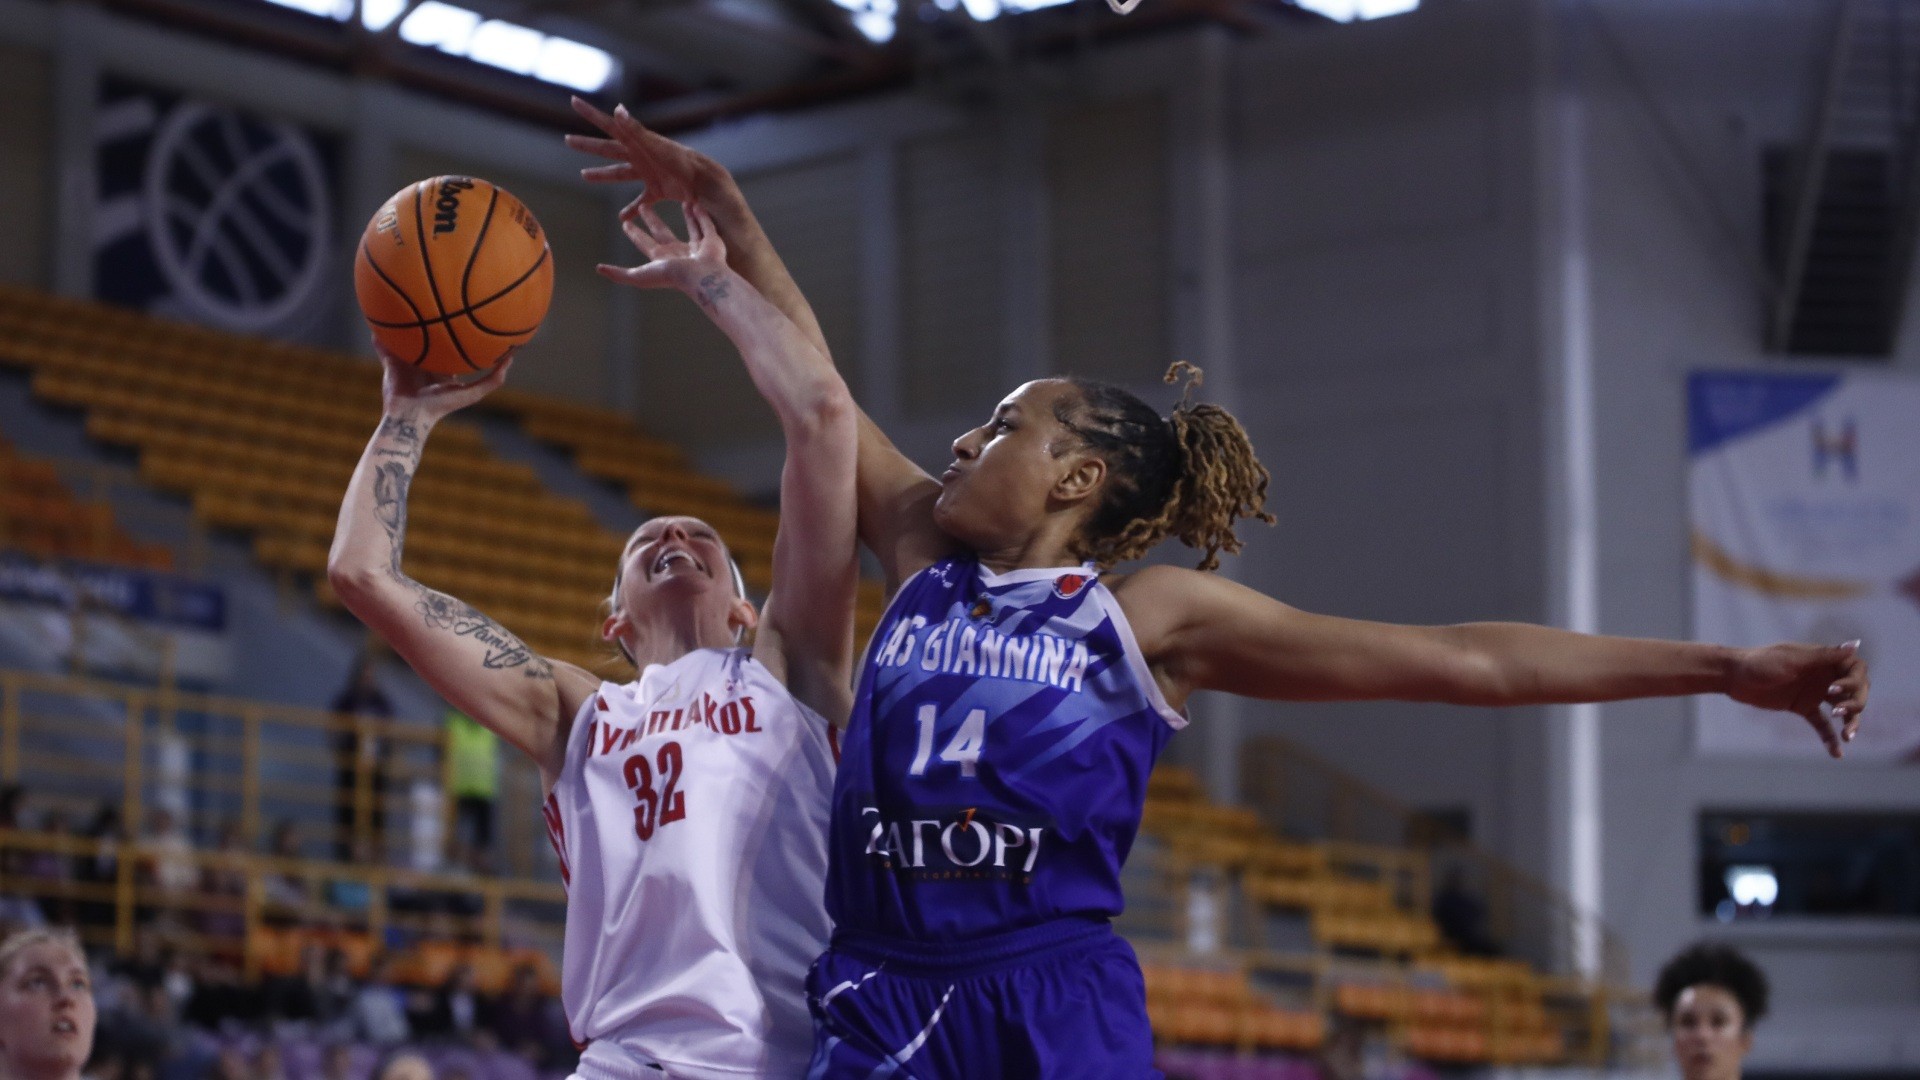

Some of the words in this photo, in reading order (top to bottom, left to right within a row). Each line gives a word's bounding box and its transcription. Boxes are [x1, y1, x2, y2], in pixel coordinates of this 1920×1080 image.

[920, 617, 1088, 693] GIANNINA
[908, 704, 986, 778] 14
[623, 741, 687, 842] 32
